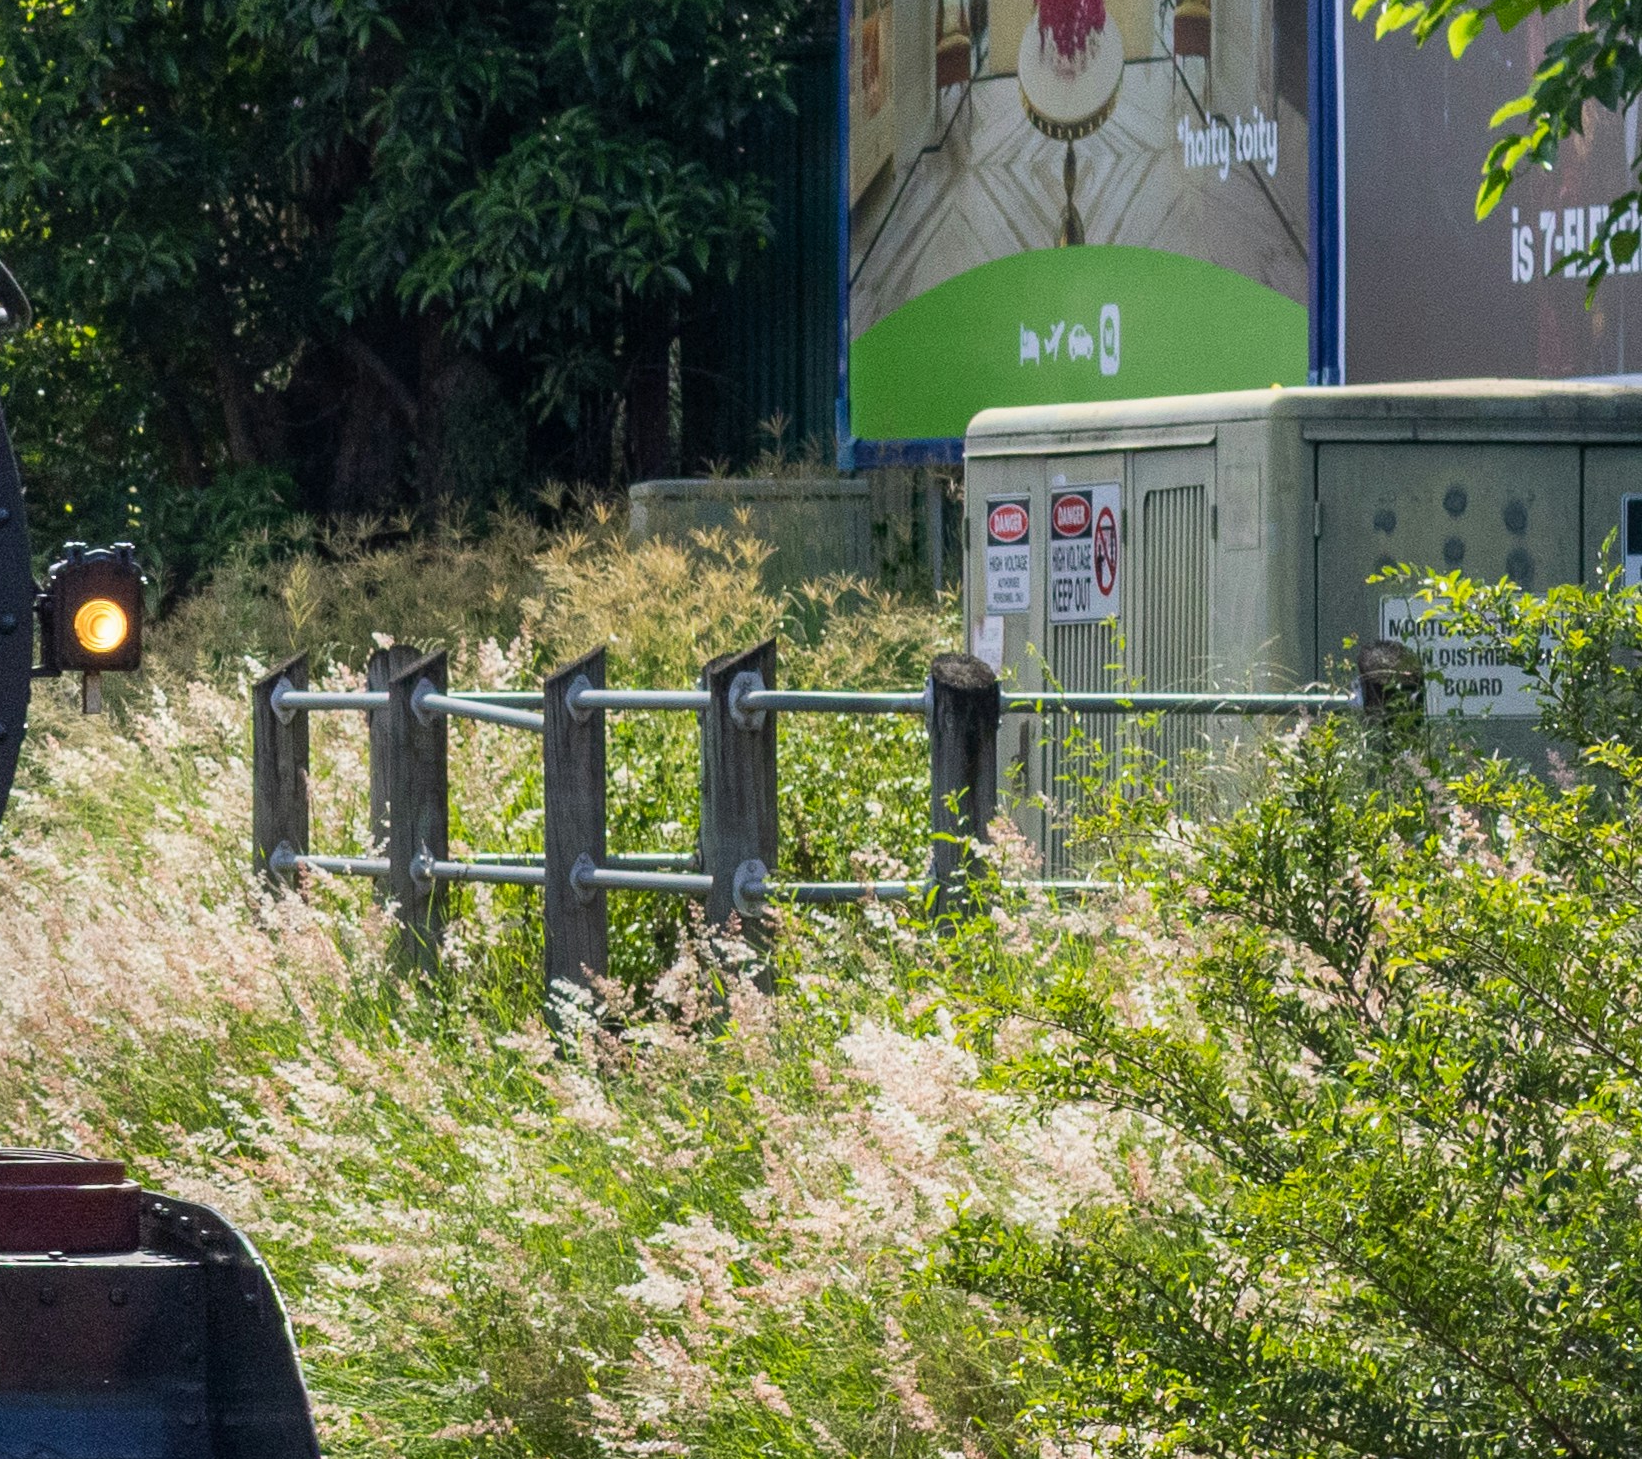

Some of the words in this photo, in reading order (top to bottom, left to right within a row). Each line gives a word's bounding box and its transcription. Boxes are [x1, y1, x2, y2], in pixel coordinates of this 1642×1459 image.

[1235, 105, 1277, 177] toity
[1511, 206, 1534, 283] is
[994, 512, 1022, 532] DANGER
[1058, 506, 1085, 527] DANGER
[989, 554, 1002, 572] HIGH
[1052, 546, 1065, 572] HIGH
[1066, 544, 1091, 572] VOLTAGE
[1053, 577, 1073, 612] KEEP
[1074, 577, 1091, 612] OUT
[1444, 677, 1503, 697] BOARD
